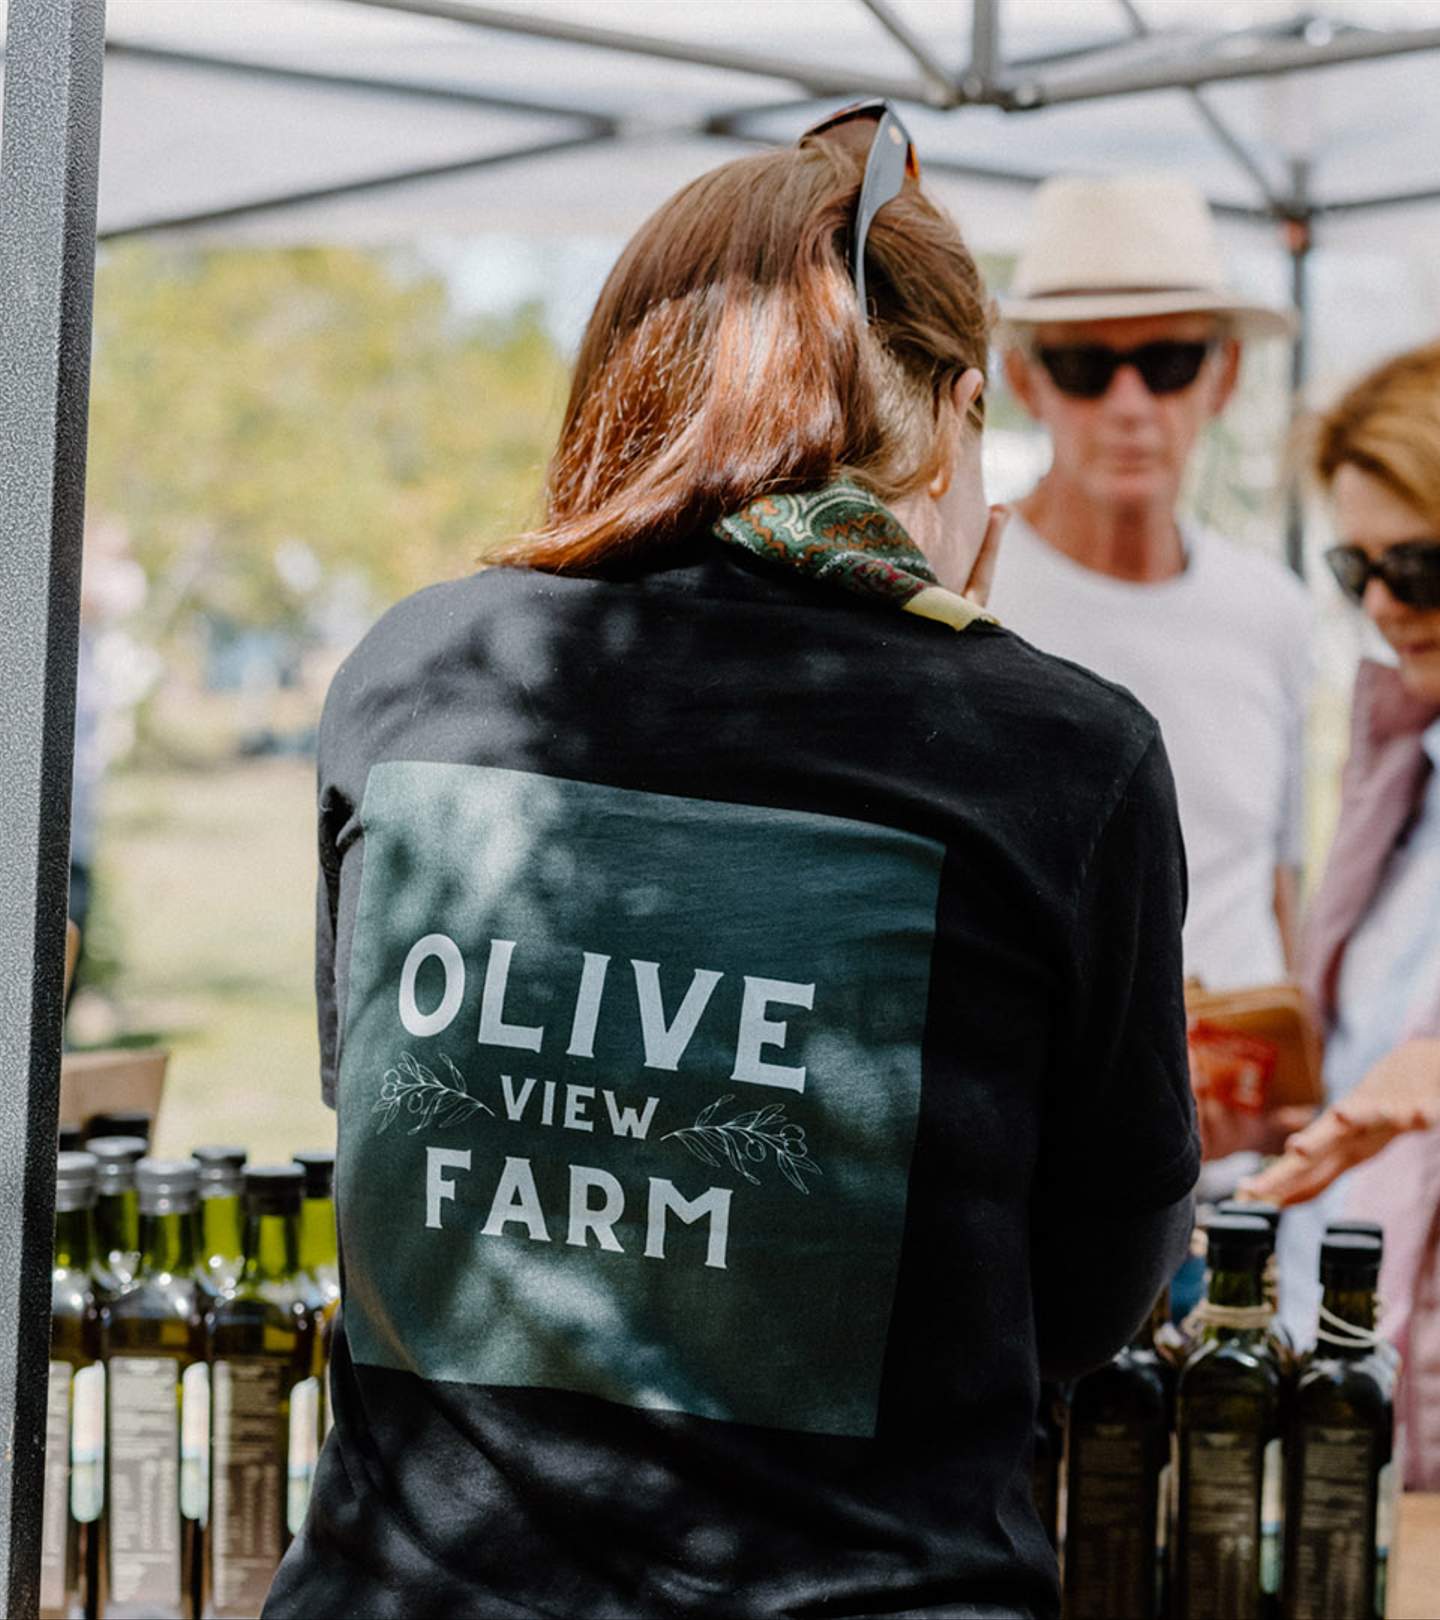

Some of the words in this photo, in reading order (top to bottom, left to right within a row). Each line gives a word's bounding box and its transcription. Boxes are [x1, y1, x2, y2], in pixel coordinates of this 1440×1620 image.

[399, 933, 815, 1094] OLIVE
[501, 1075, 660, 1140] VIEW
[425, 1146, 733, 1269] FARM
